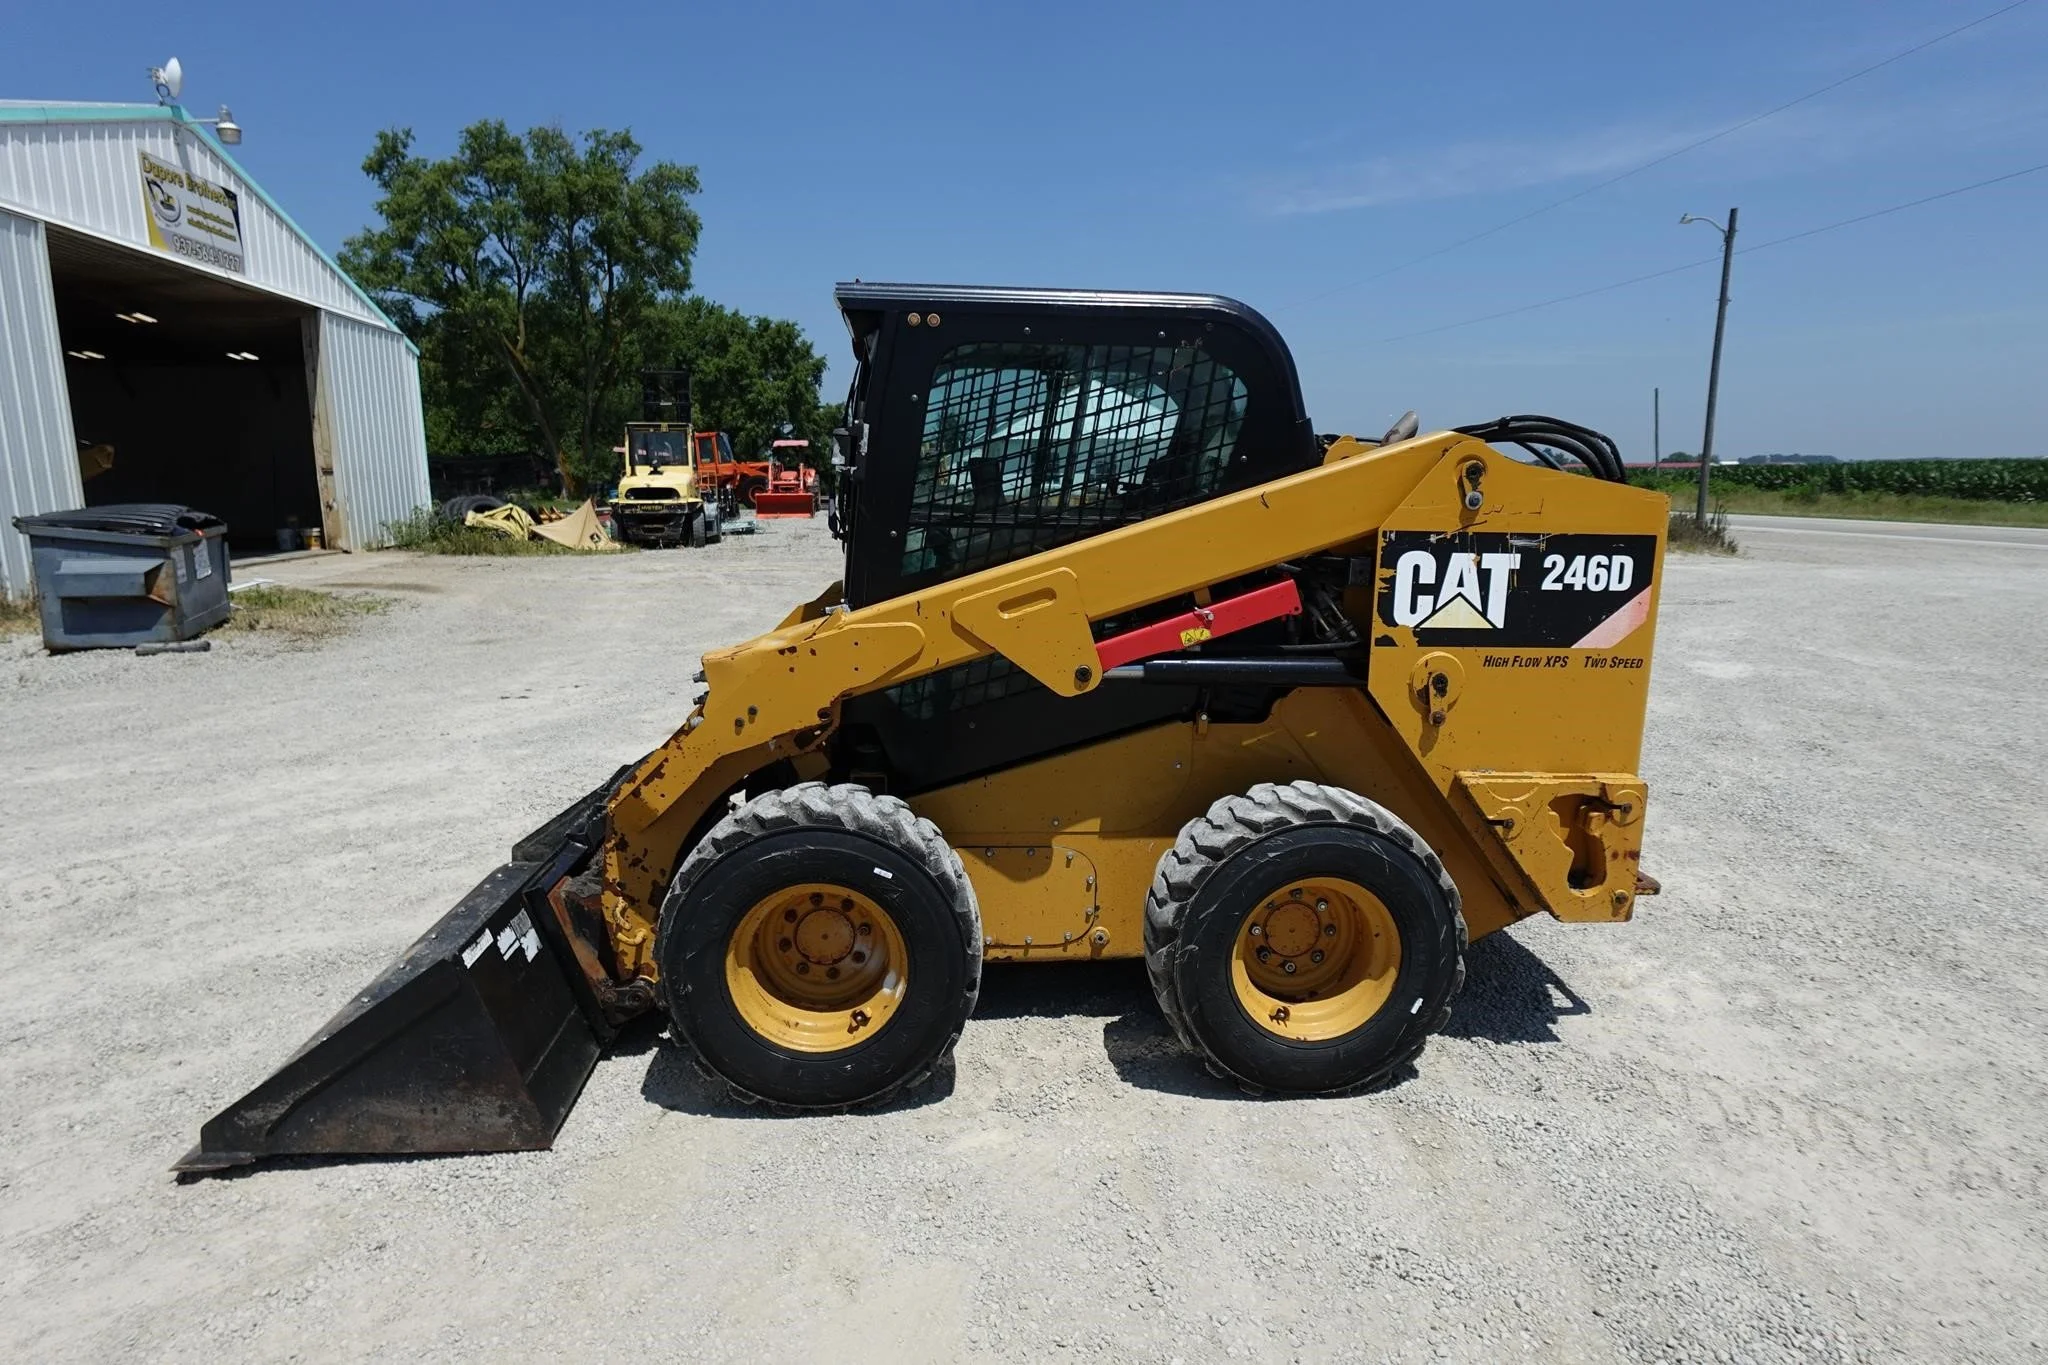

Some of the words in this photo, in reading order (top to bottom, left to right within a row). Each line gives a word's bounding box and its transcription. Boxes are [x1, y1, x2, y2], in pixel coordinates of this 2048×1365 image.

[1393, 550, 1521, 629] CAT
[1541, 554, 1635, 592] 246D
[1544, 656, 1569, 668] XPS
